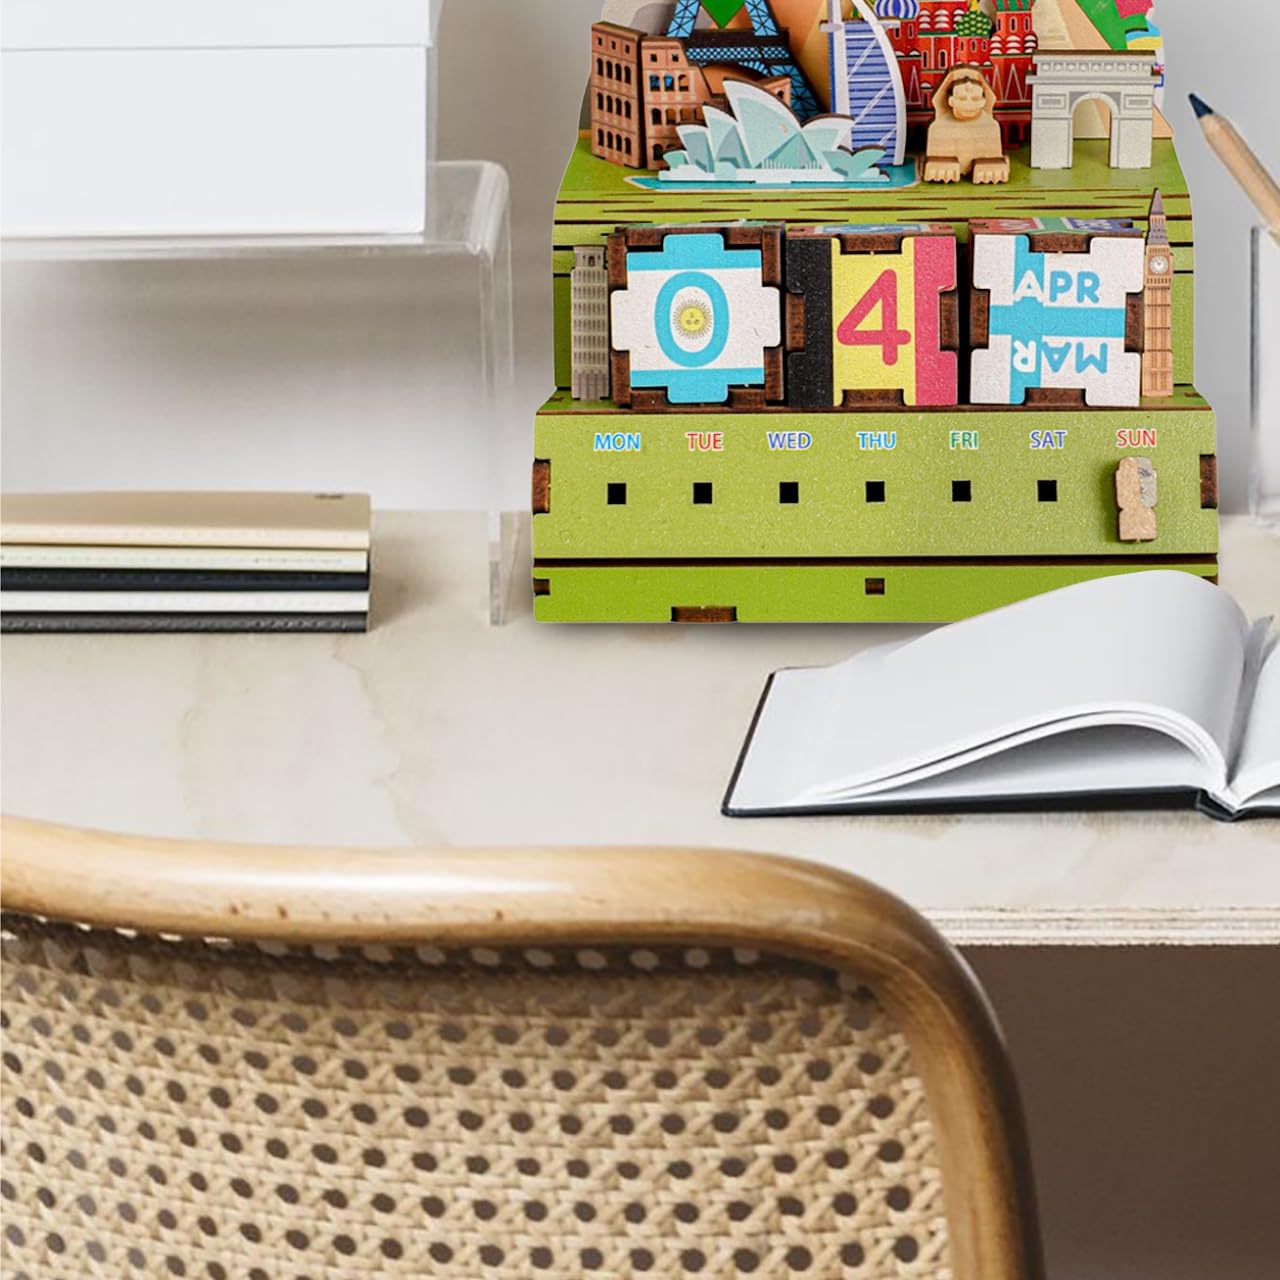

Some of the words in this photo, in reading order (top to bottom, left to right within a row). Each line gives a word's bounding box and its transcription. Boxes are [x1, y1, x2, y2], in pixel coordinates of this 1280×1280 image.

[1013, 269, 1101, 304] APR
[654, 271, 730, 368] 0
[837, 269, 911, 366] 4
[1014, 339, 1109, 375] MAR
[594, 432, 641, 451] MON
[687, 432, 724, 451] TUE
[768, 432, 812, 450] WED
[857, 431, 897, 450] THU
[950, 431, 979, 449] FRI
[1030, 431, 1068, 449] SAT
[1116, 430, 1157, 448] SUN
